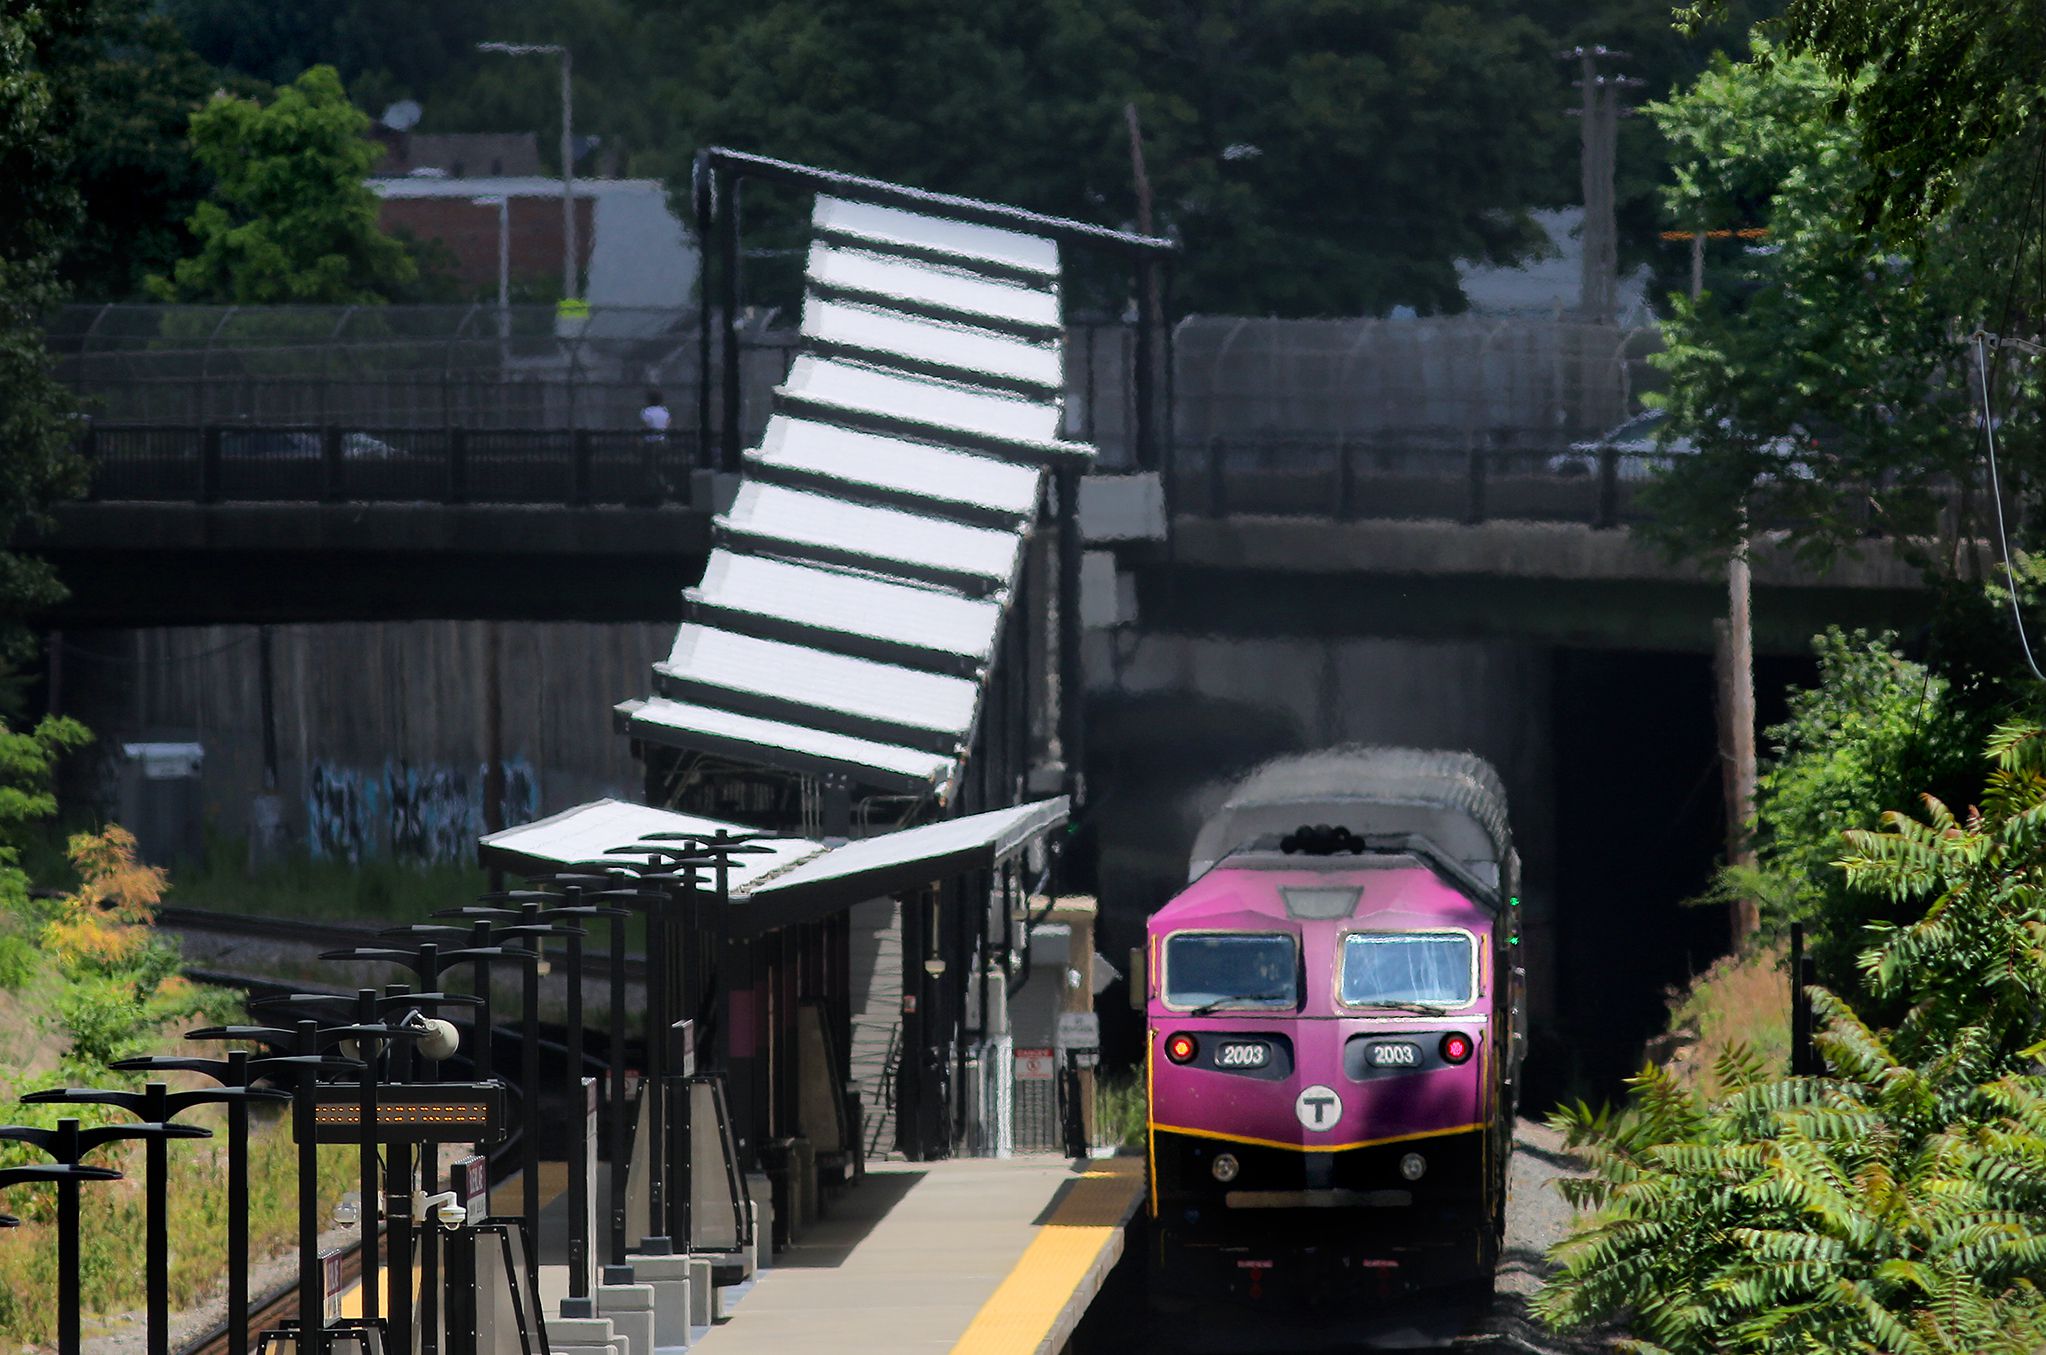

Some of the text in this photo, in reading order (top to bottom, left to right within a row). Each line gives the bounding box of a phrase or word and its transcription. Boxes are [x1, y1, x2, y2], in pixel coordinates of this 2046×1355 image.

[1224, 1045, 1264, 1064] 2003
[1374, 1045, 1414, 1064] 2003
[1303, 1097, 1335, 1123] T
